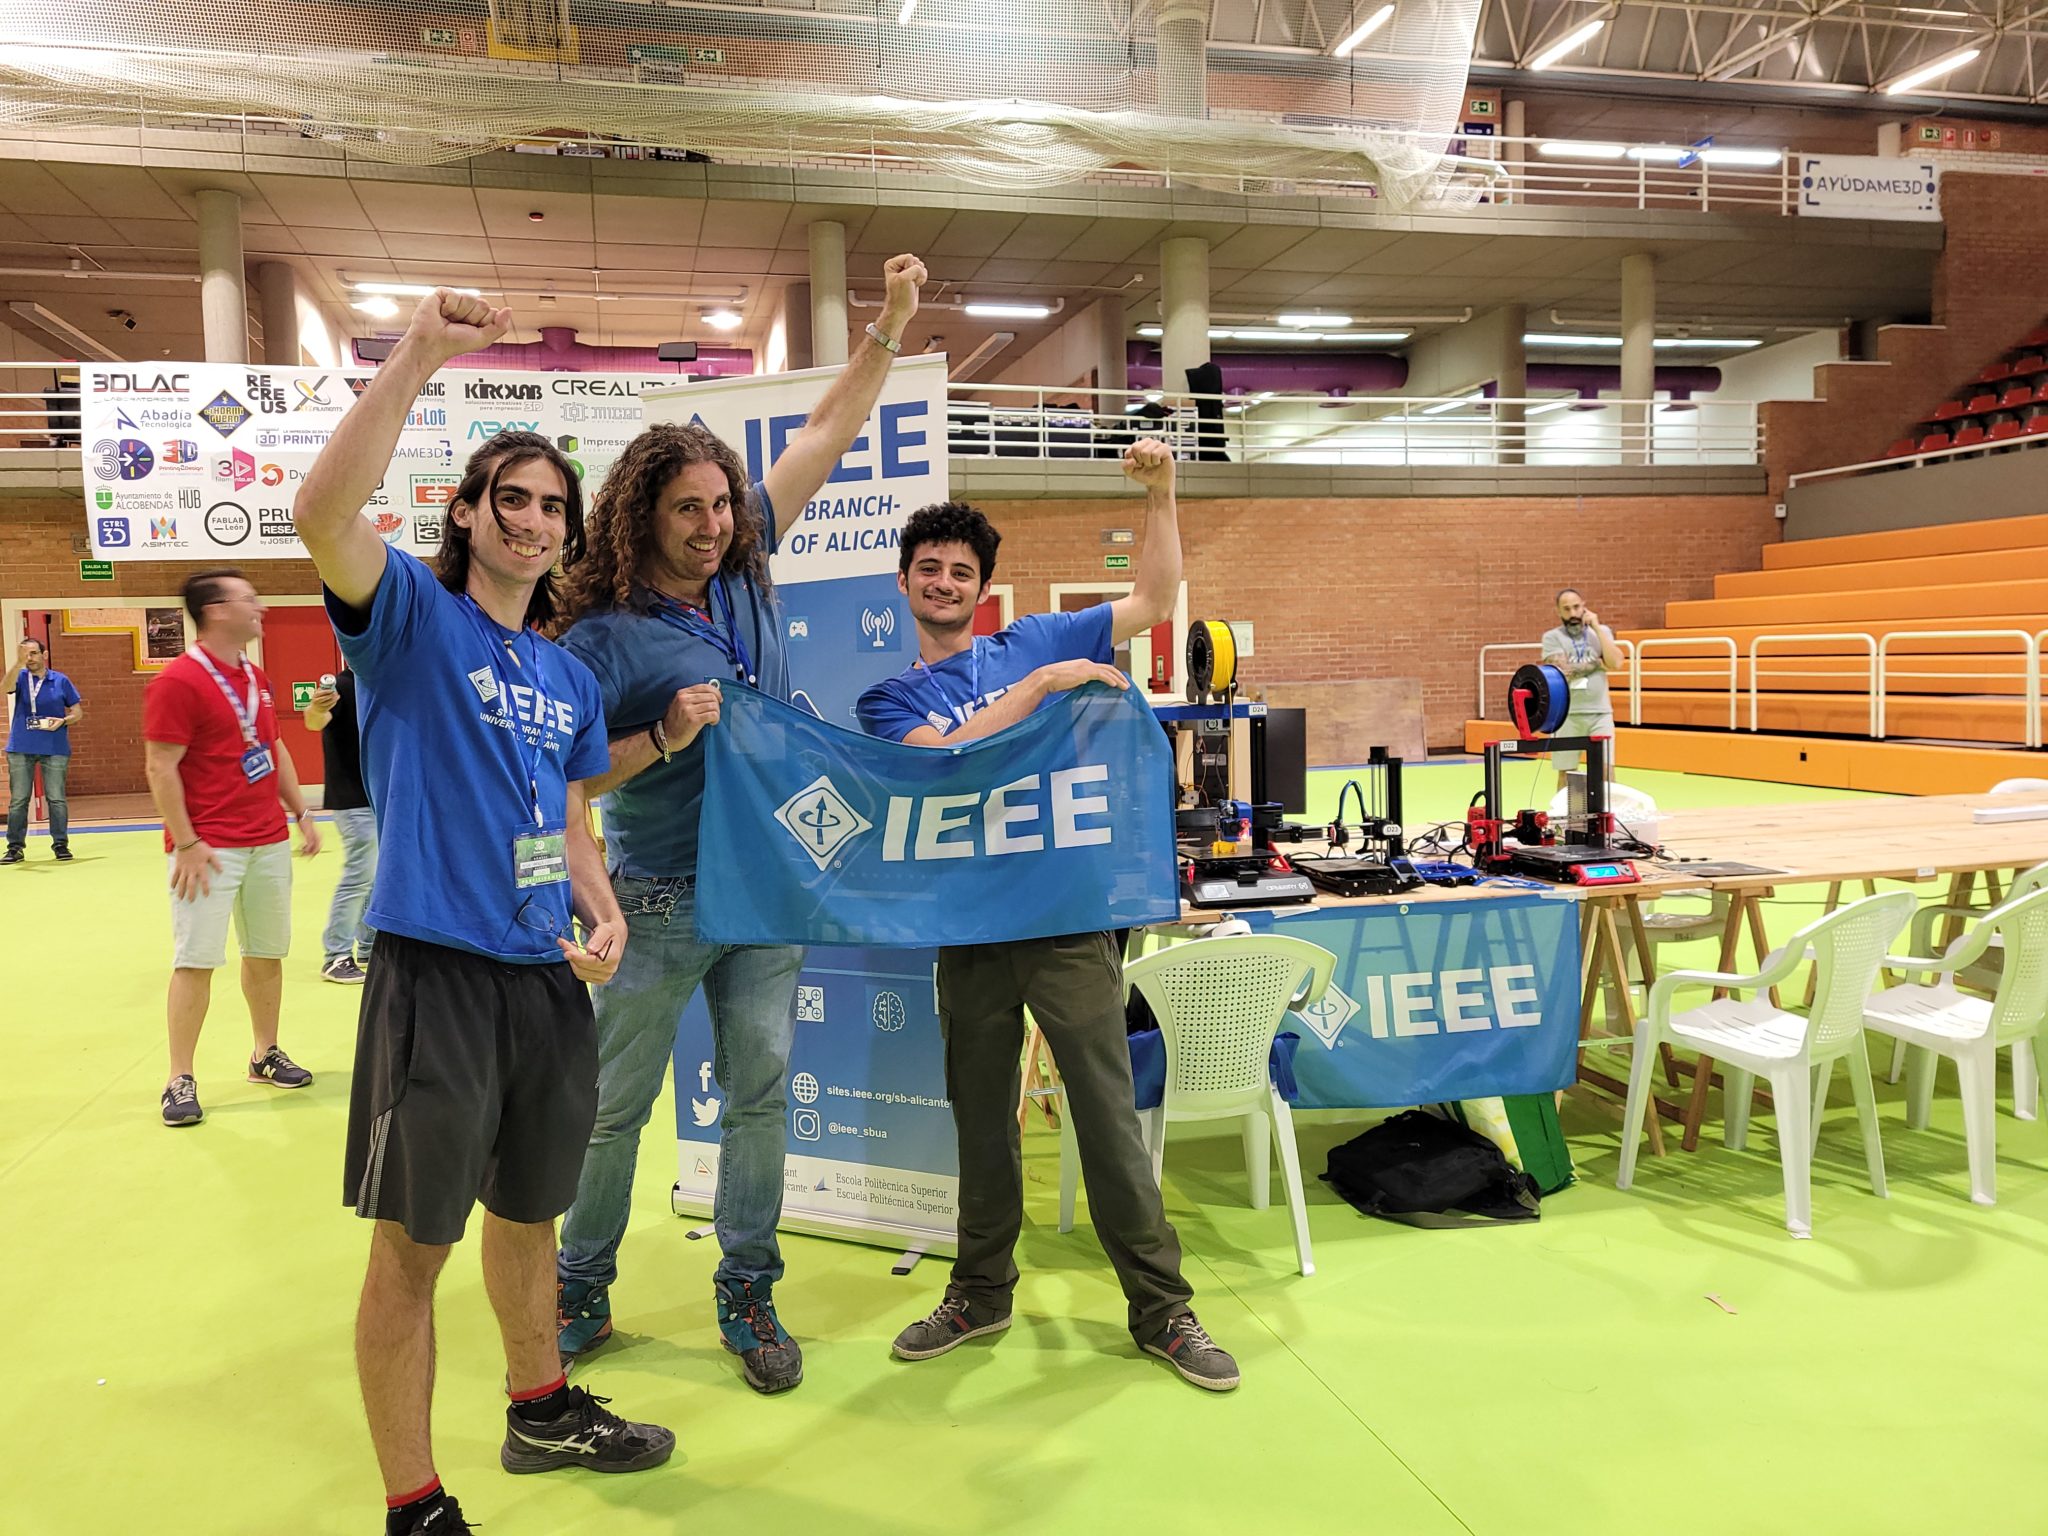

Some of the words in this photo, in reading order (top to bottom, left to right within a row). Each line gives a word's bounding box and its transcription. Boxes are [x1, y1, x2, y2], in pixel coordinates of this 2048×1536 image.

[1816, 174, 1922, 195] AYÚDAME3D
[93, 374, 190, 393] 3DLAC
[419, 383, 445, 396] OGIC
[552, 380, 676, 396] CREAL
[247, 388, 285, 400] CRE
[261, 401, 287, 413] US
[583, 437, 630, 447] Impresor
[391, 447, 444, 459] DAME3D
[178, 490, 201, 509] HUB
[259, 508, 294, 521] PRU
[791, 533, 819, 555] OF
[825, 527, 904, 553] ALICAN
[882, 764, 1112, 861] IEEE
[1366, 964, 1543, 1039] IEEE
[826, 1085, 951, 1109] sites.ieee.org/sb-alicante
[828, 1122, 888, 1139] @ieee_sbua
[784, 1181, 808, 1193] icante
[835, 1172, 862, 1187] Escola
[910, 1184, 948, 1200] Superior
[836, 1188, 868, 1202] Escuela
[916, 1198, 954, 1215] Superior
